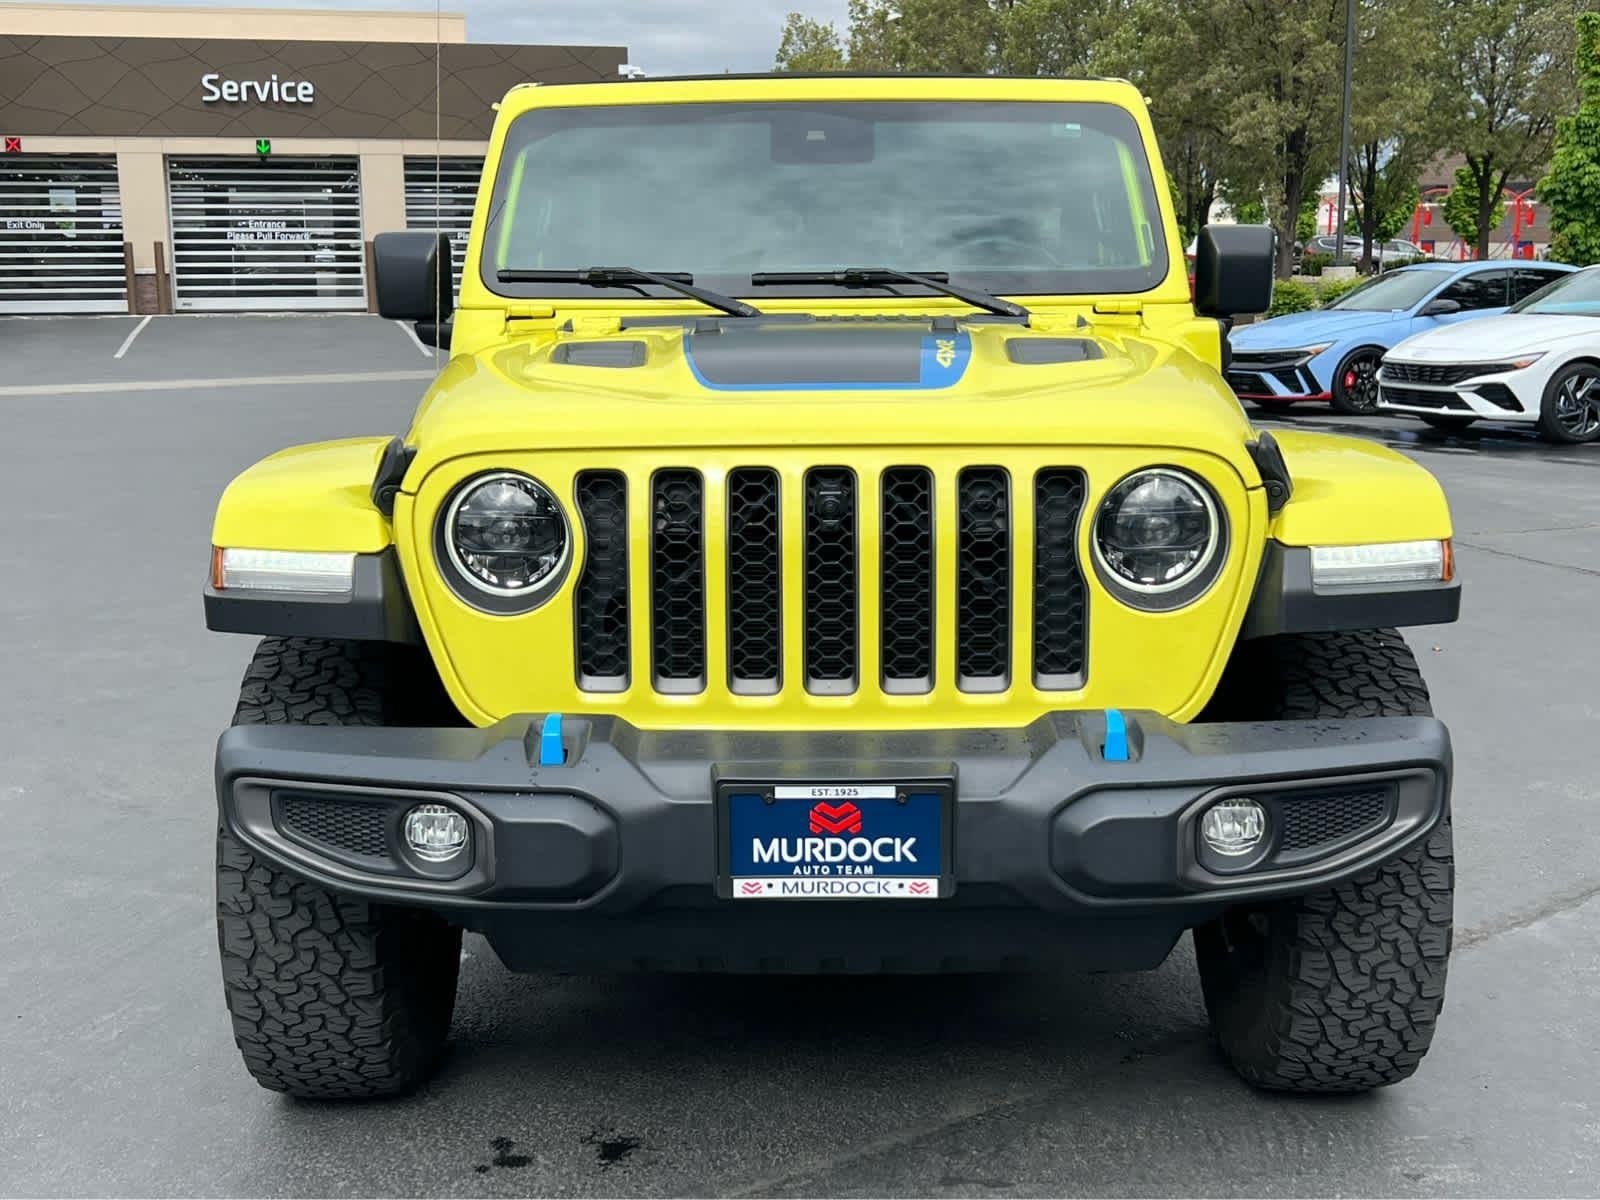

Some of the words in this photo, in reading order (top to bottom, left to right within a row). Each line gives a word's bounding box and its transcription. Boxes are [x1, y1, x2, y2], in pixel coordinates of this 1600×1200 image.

[202, 74, 314, 102] Service
[7, 220, 23, 229] Exit
[26, 220, 45, 230] Only
[248, 220, 286, 228] Entrance
[227, 231, 254, 240] Please
[257, 231, 272, 240] Pull
[275, 231, 310, 240] Forward
[811, 788, 832, 796] EST.
[835, 788, 859, 796] 1925
[752, 837, 918, 863] MURDOCK
[793, 865, 830, 875] AUTO
[836, 865, 873, 875] TEAM
[781, 881, 891, 894] MURDOCK
